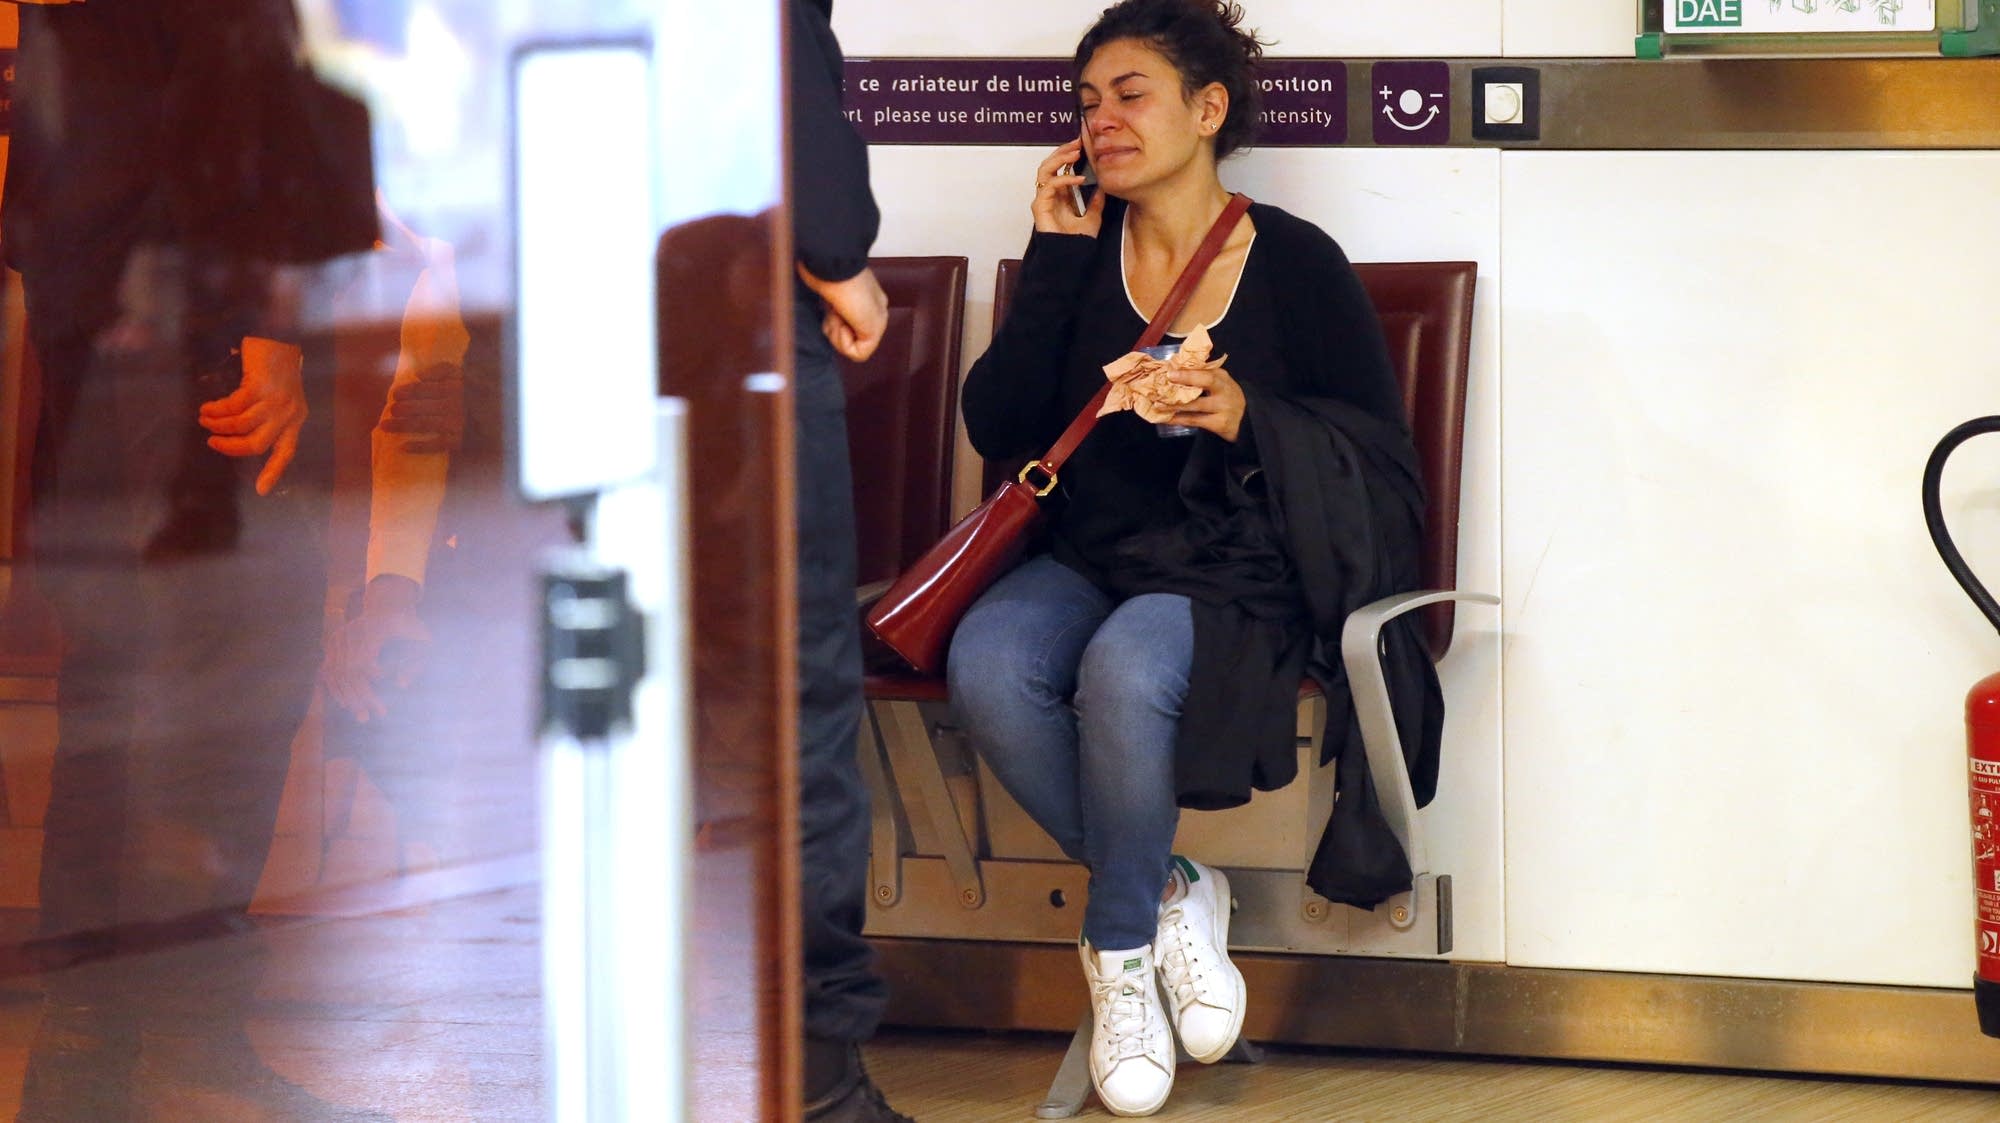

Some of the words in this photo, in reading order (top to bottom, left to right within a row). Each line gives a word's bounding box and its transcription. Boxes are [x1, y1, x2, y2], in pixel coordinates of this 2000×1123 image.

[1678, 0, 1739, 22] DAE
[859, 78, 880, 92] ce
[987, 76, 1010, 92] de
[874, 106, 931, 126] please
[938, 110, 968, 123] use
[974, 107, 1044, 124] dimmer
[1259, 107, 1332, 128] ntensity
